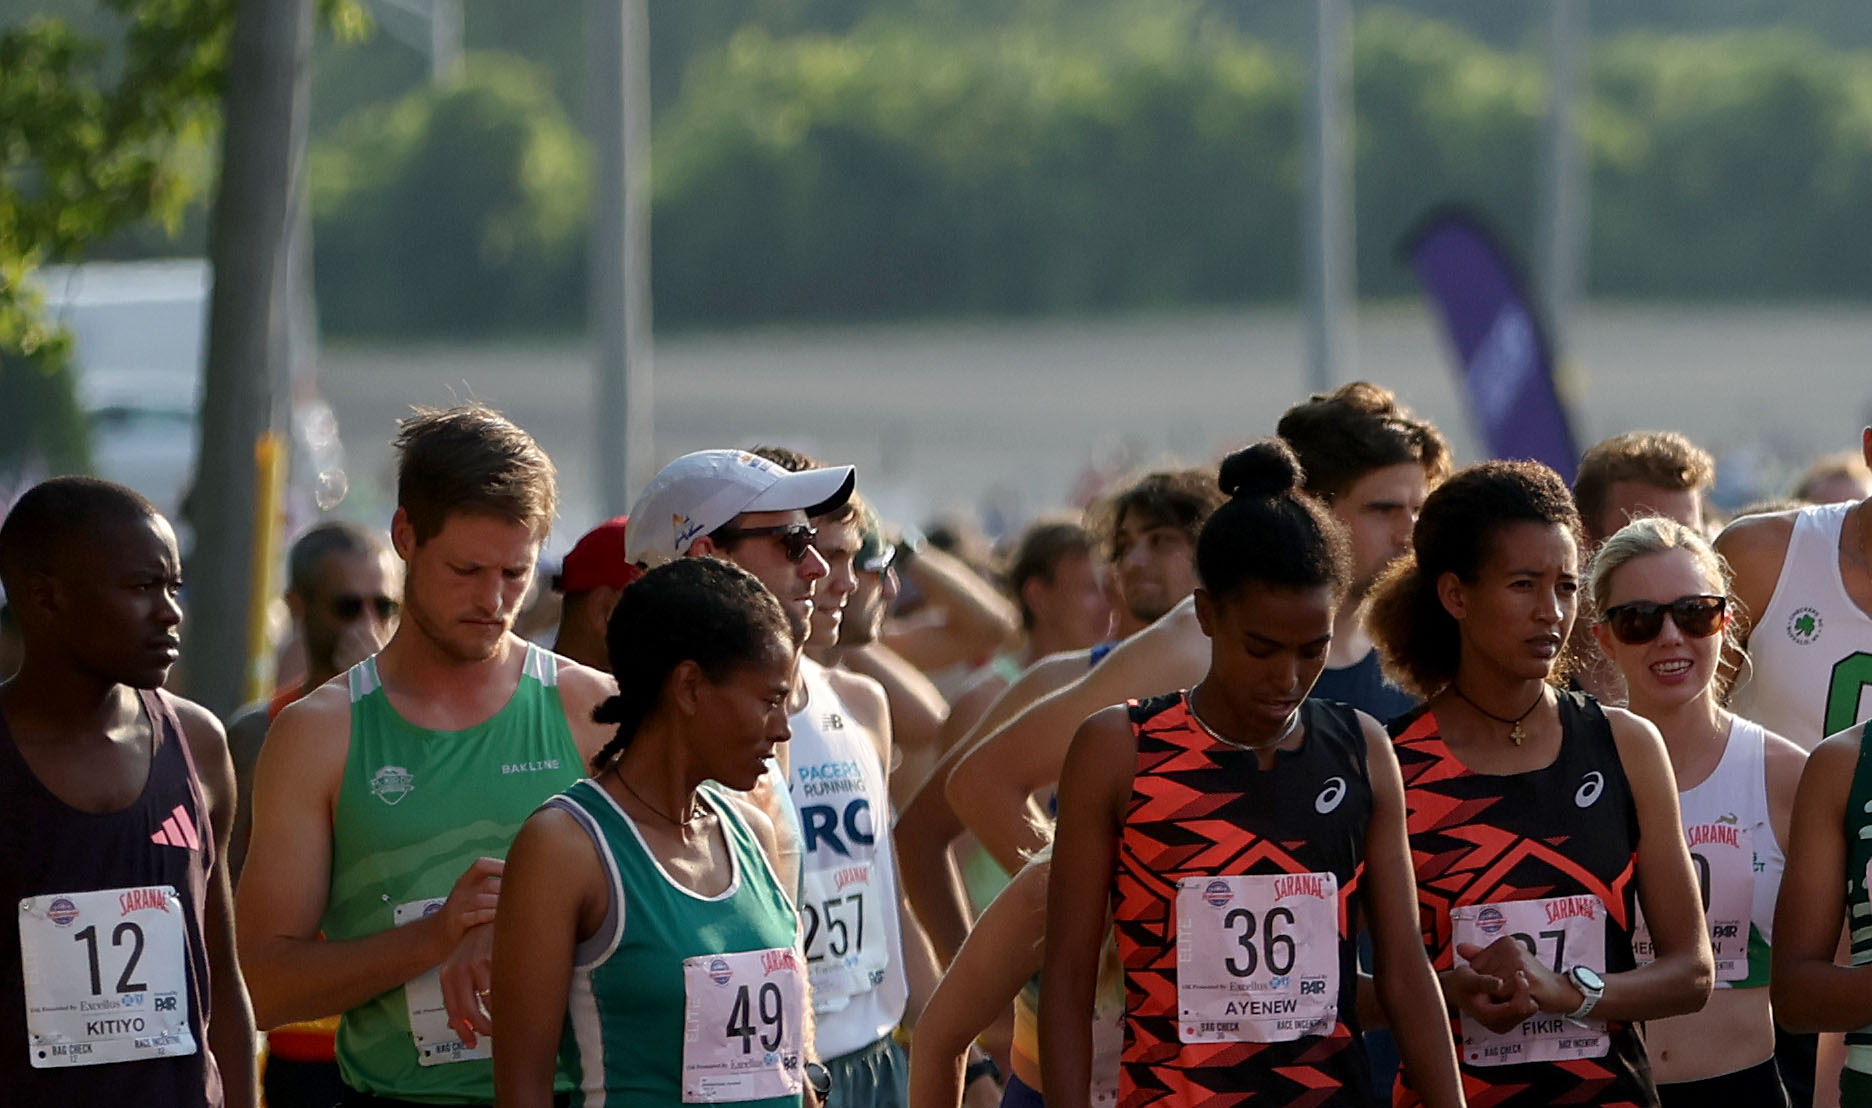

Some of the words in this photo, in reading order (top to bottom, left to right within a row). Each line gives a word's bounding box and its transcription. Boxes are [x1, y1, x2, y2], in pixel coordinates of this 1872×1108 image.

[502, 760, 560, 774] BAKLINE
[804, 777, 866, 798] RUNNING
[1688, 824, 1740, 848] SARANAC
[1274, 875, 1325, 902] SARANAC
[1544, 898, 1596, 925] SARANAC
[802, 893, 863, 962] 257
[1713, 926, 1738, 939] PAR
[1224, 907, 1296, 977] 36
[74, 922, 147, 995] 12
[1230, 981, 1268, 992] Excellus
[1301, 980, 1326, 995] PAR
[80, 1000, 120, 1011] Excellus
[154, 997, 177, 1012] PAR
[1225, 999, 1297, 1016] AYENEW
[87, 1017, 145, 1035] KITIYO
[726, 982, 783, 1054] 49
[1522, 1019, 1564, 1036] FIKIR
